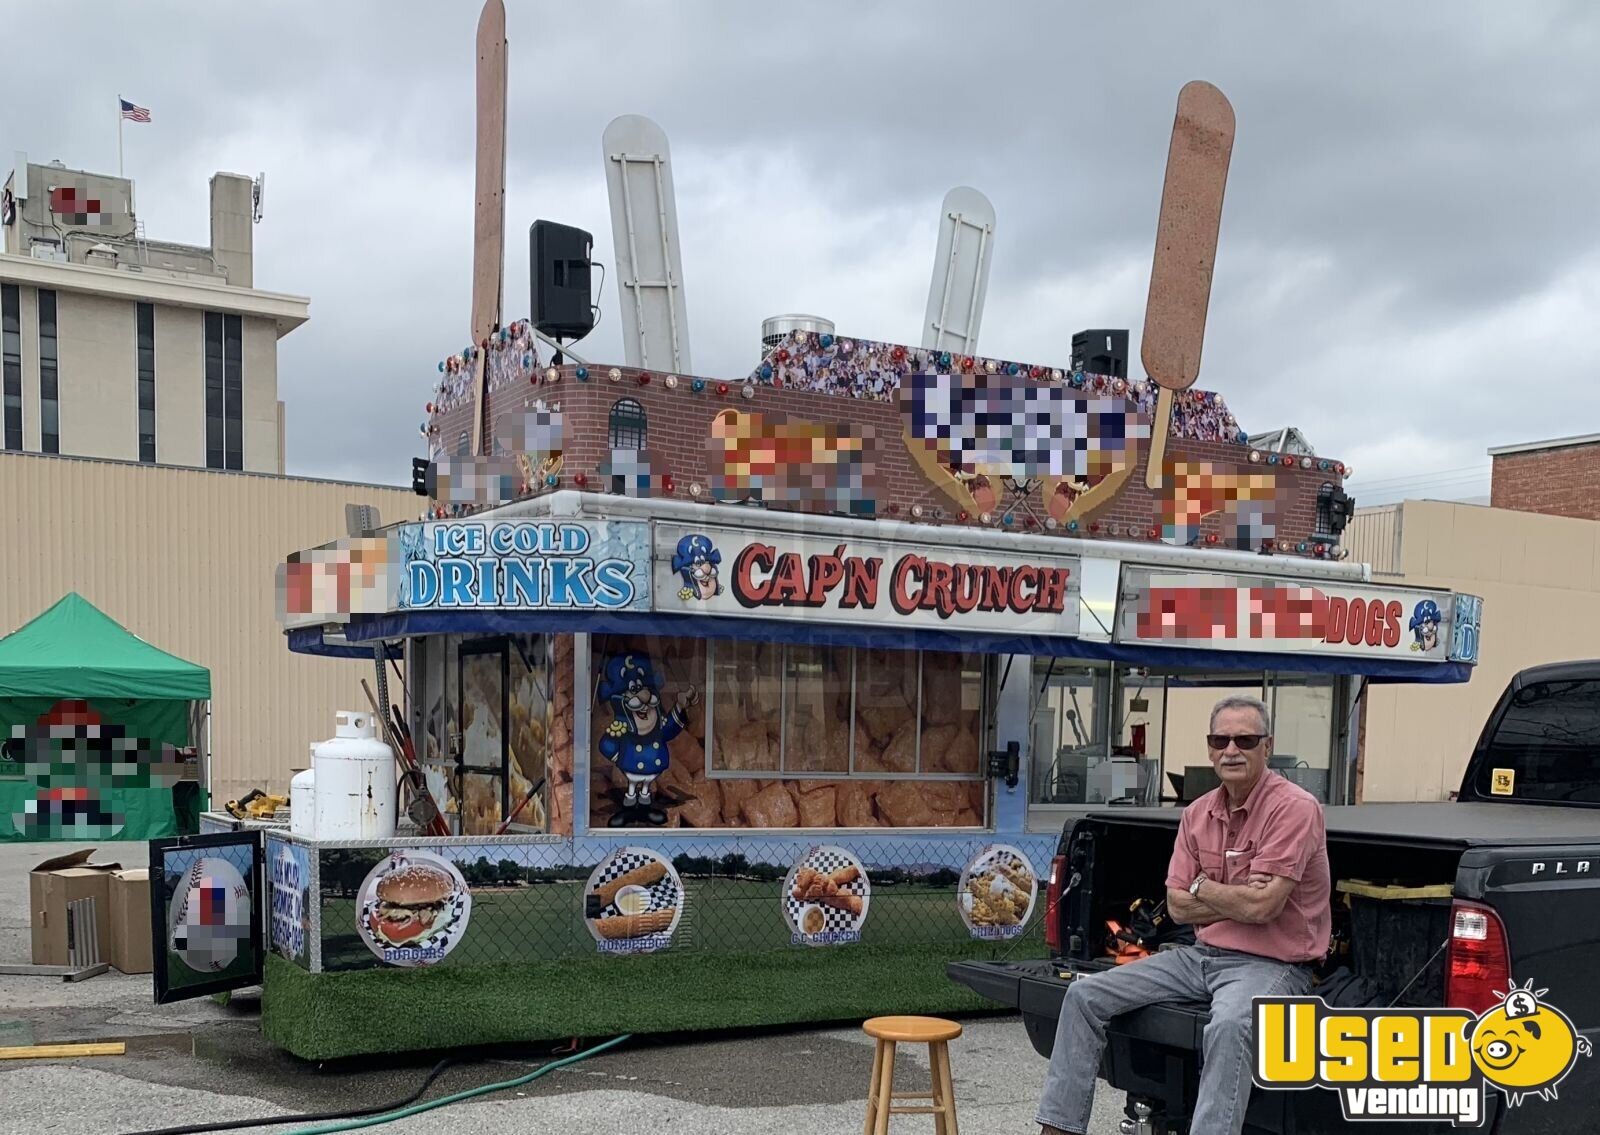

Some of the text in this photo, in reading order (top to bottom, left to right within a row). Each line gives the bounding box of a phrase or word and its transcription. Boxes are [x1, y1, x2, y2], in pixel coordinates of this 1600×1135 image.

[434, 523, 590, 555] ICE COLD
[408, 557, 635, 608] DRINKS
[731, 543, 883, 609] CAP'N
[889, 553, 1070, 620] CRUNCH
[1532, 861, 1590, 875] PLA
[383, 946, 446, 961] BURGERS
